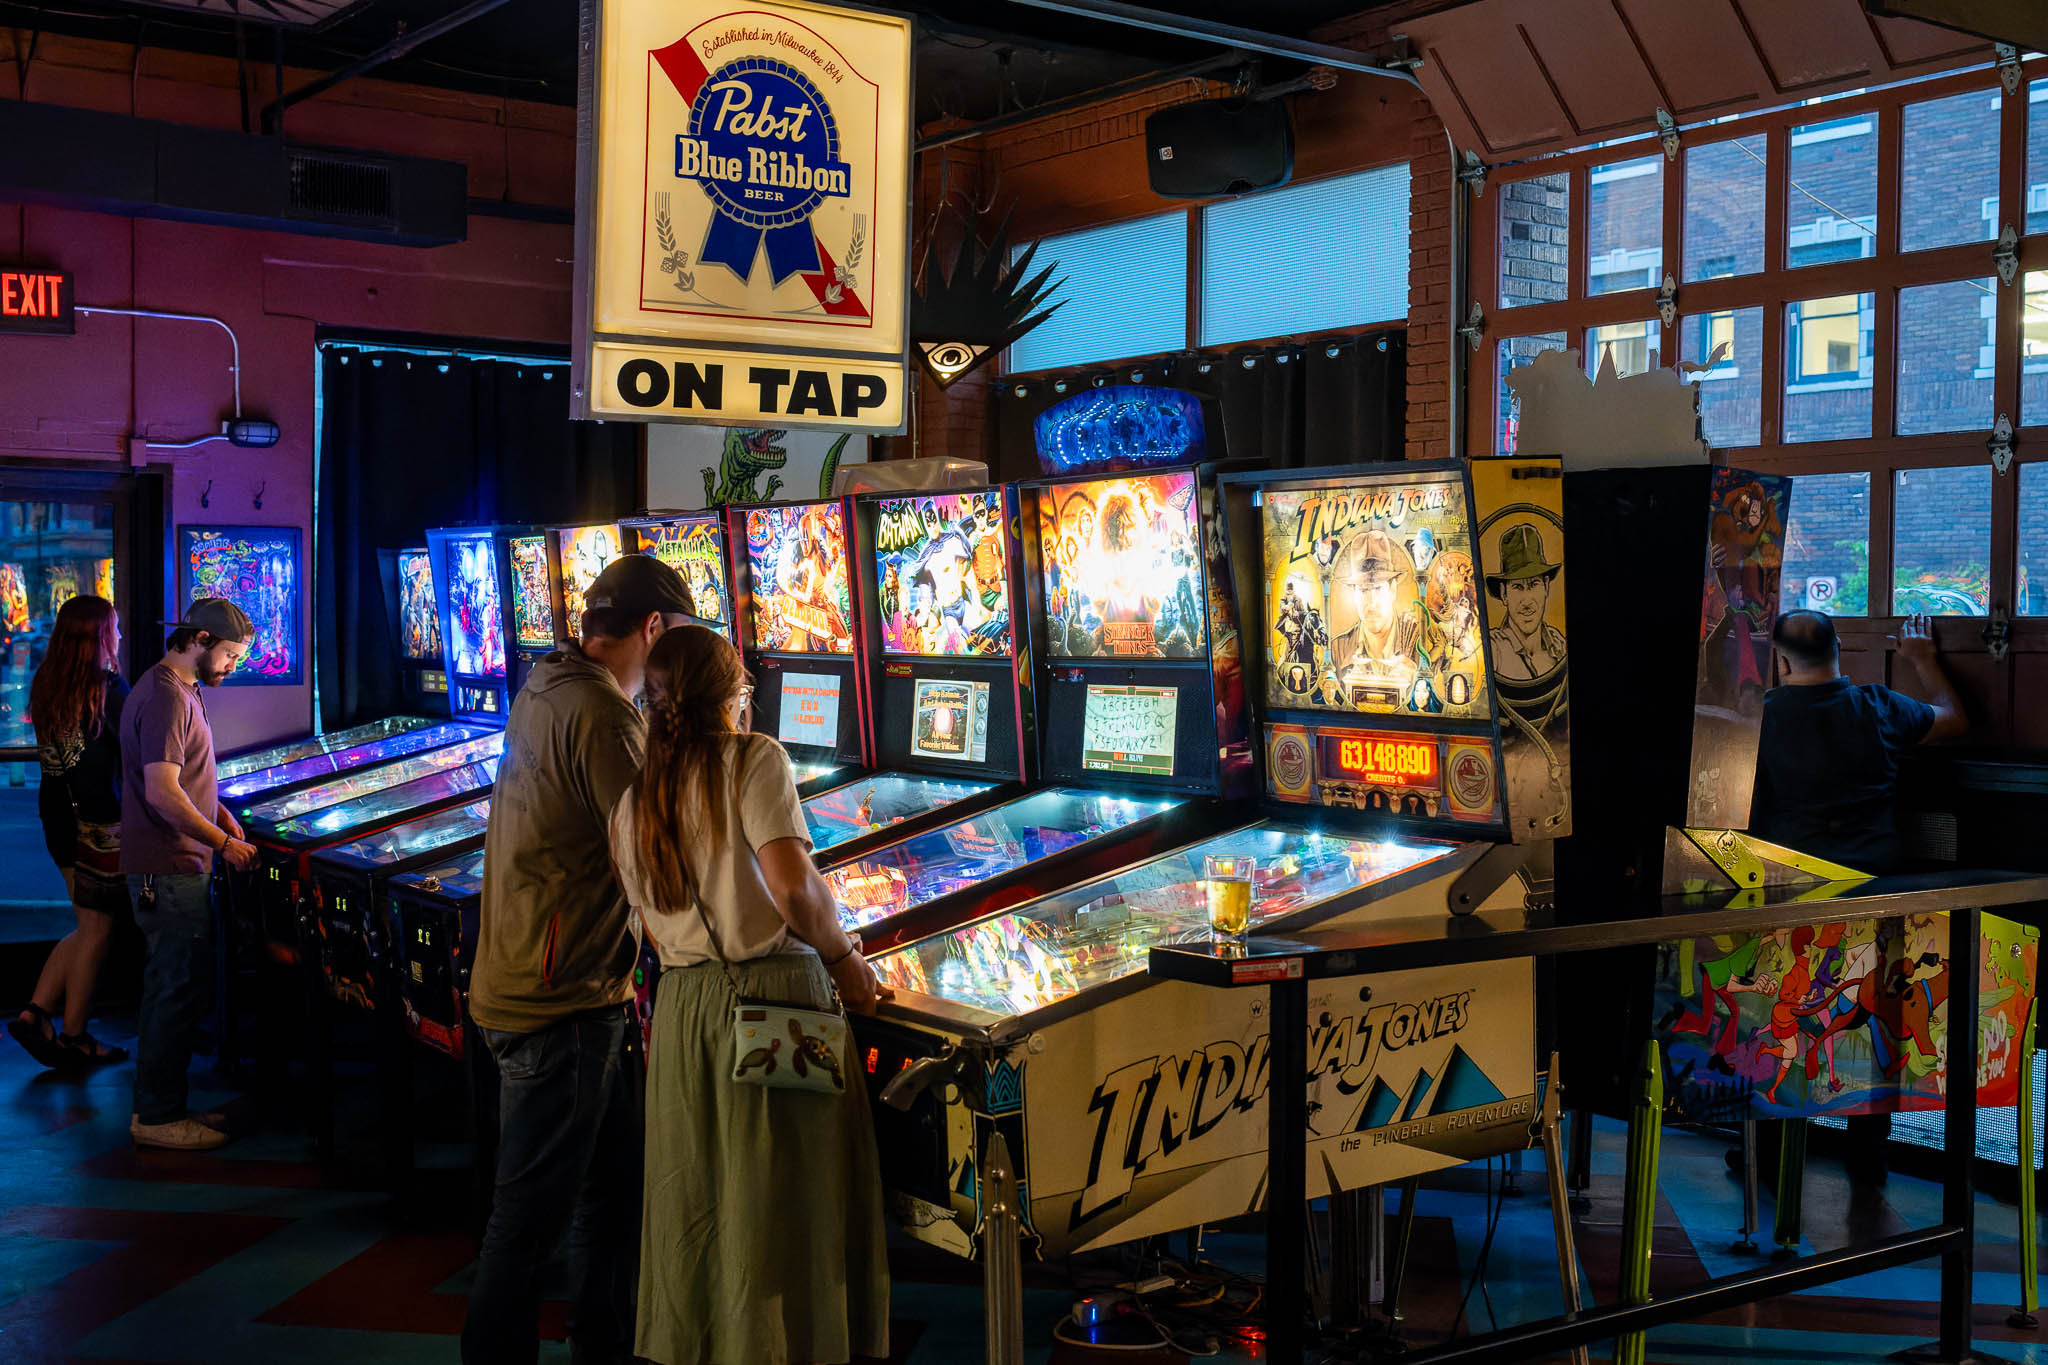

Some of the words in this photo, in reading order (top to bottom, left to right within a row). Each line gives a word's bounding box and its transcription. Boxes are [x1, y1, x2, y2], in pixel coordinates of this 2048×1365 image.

[702, 27, 760, 59] Established
[761, 28, 774, 41] in
[774, 30, 825, 68] Milwaukee
[823, 60, 844, 84] 1844
[710, 80, 812, 142] Pabst
[678, 137, 742, 183] Blue
[747, 147, 847, 194] Ribbon
[744, 189, 784, 202] BEER
[2, 272, 63, 318] EXIT
[617, 358, 724, 410] ON
[748, 366, 887, 418] TAP
[878, 504, 923, 551] BATMAN
[1290, 492, 1396, 563] INDIANA
[1389, 488, 1449, 529] JONES
[655, 527, 722, 573] METALLICA
[1104, 624, 1155, 643] STRANGER
[1113, 640, 1147, 655] THINGS
[1340, 740, 1431, 775] 63,148,890
[1366, 773, 1396, 783] CREDITS
[1337, 991, 1470, 1095] JONES
[1341, 1137, 1361, 1152] the
[1373, 1122, 1435, 1147] PINBALL
[1447, 1100, 1529, 1132] ADVENTURE
